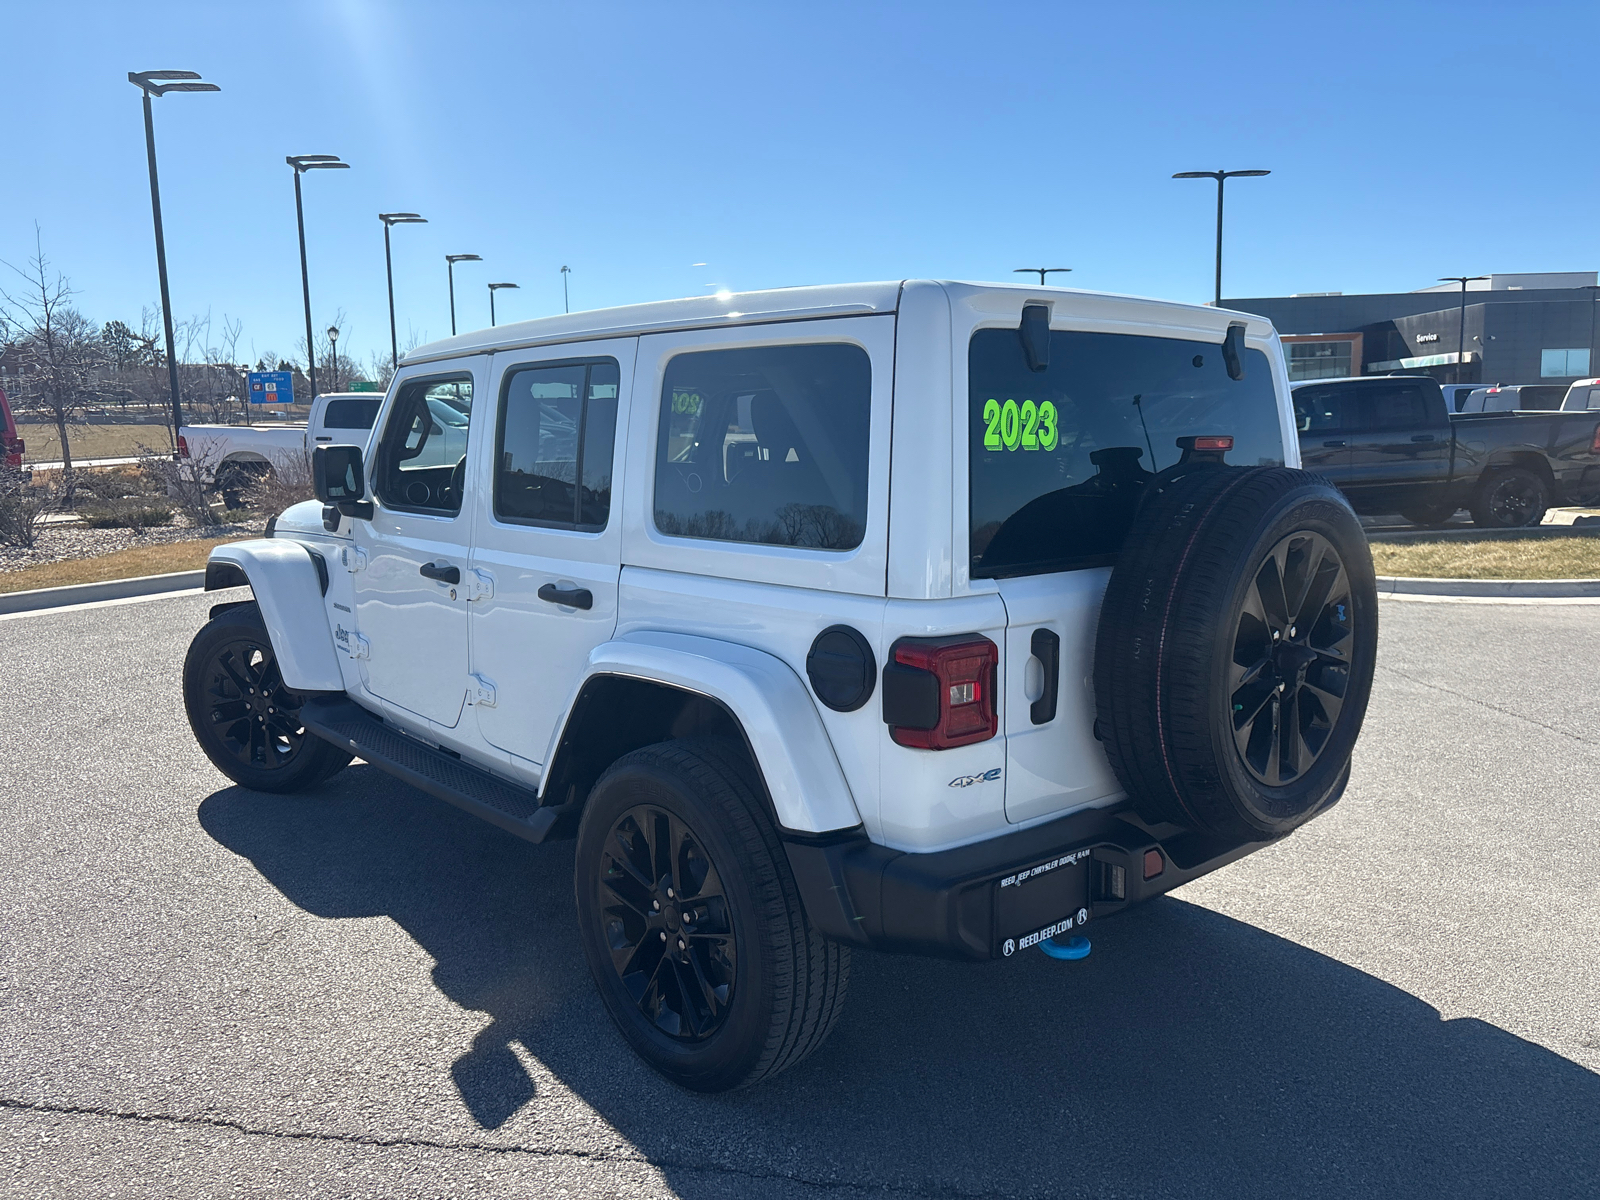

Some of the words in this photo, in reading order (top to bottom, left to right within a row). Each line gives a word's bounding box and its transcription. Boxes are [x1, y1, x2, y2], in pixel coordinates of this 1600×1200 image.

[1416, 332, 1437, 342] Service
[983, 398, 1058, 452] 2023
[1001, 875, 1016, 888] REED
[1016, 870, 1030, 882] JEEP
[1031, 860, 1058, 876] CHRYSLER
[1059, 852, 1076, 866] DODGE
[1077, 849, 1090, 859] RAM
[1019, 918, 1073, 950] REEDJEEP.COM
